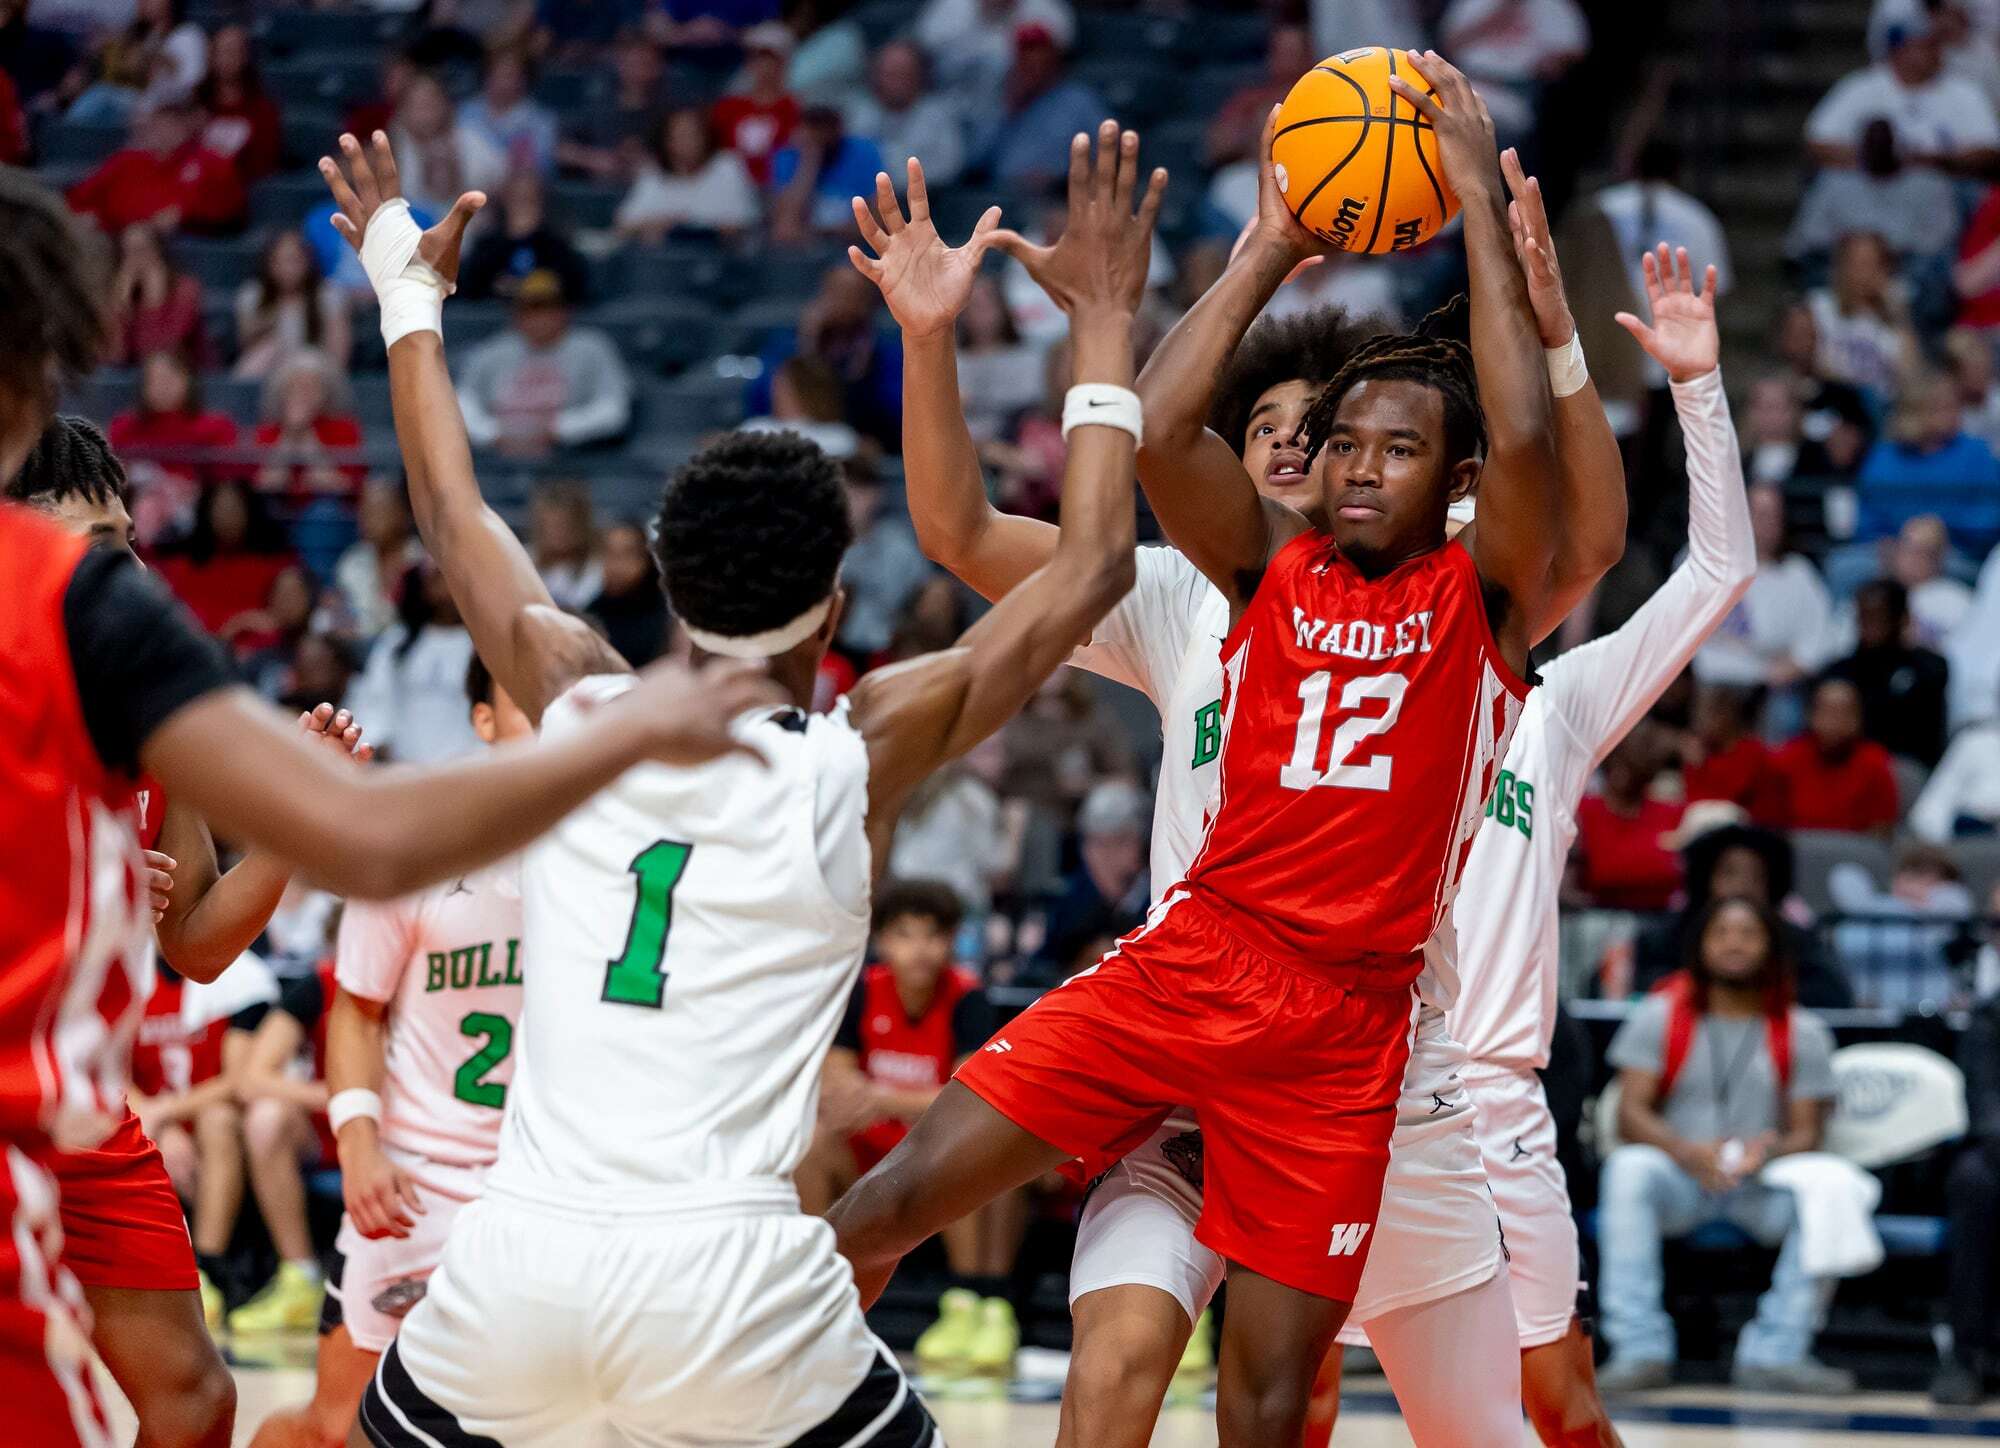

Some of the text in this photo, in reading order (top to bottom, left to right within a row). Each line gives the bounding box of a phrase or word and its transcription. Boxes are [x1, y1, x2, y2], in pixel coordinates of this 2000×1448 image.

[1293, 606, 1433, 660] WADLEY
[1280, 671, 1410, 791] 12
[1485, 769, 1534, 841] GS
[601, 839, 693, 1008] 1
[426, 939, 523, 992] BULL
[454, 1012, 513, 1110] 2
[1328, 1223, 1370, 1256] W
